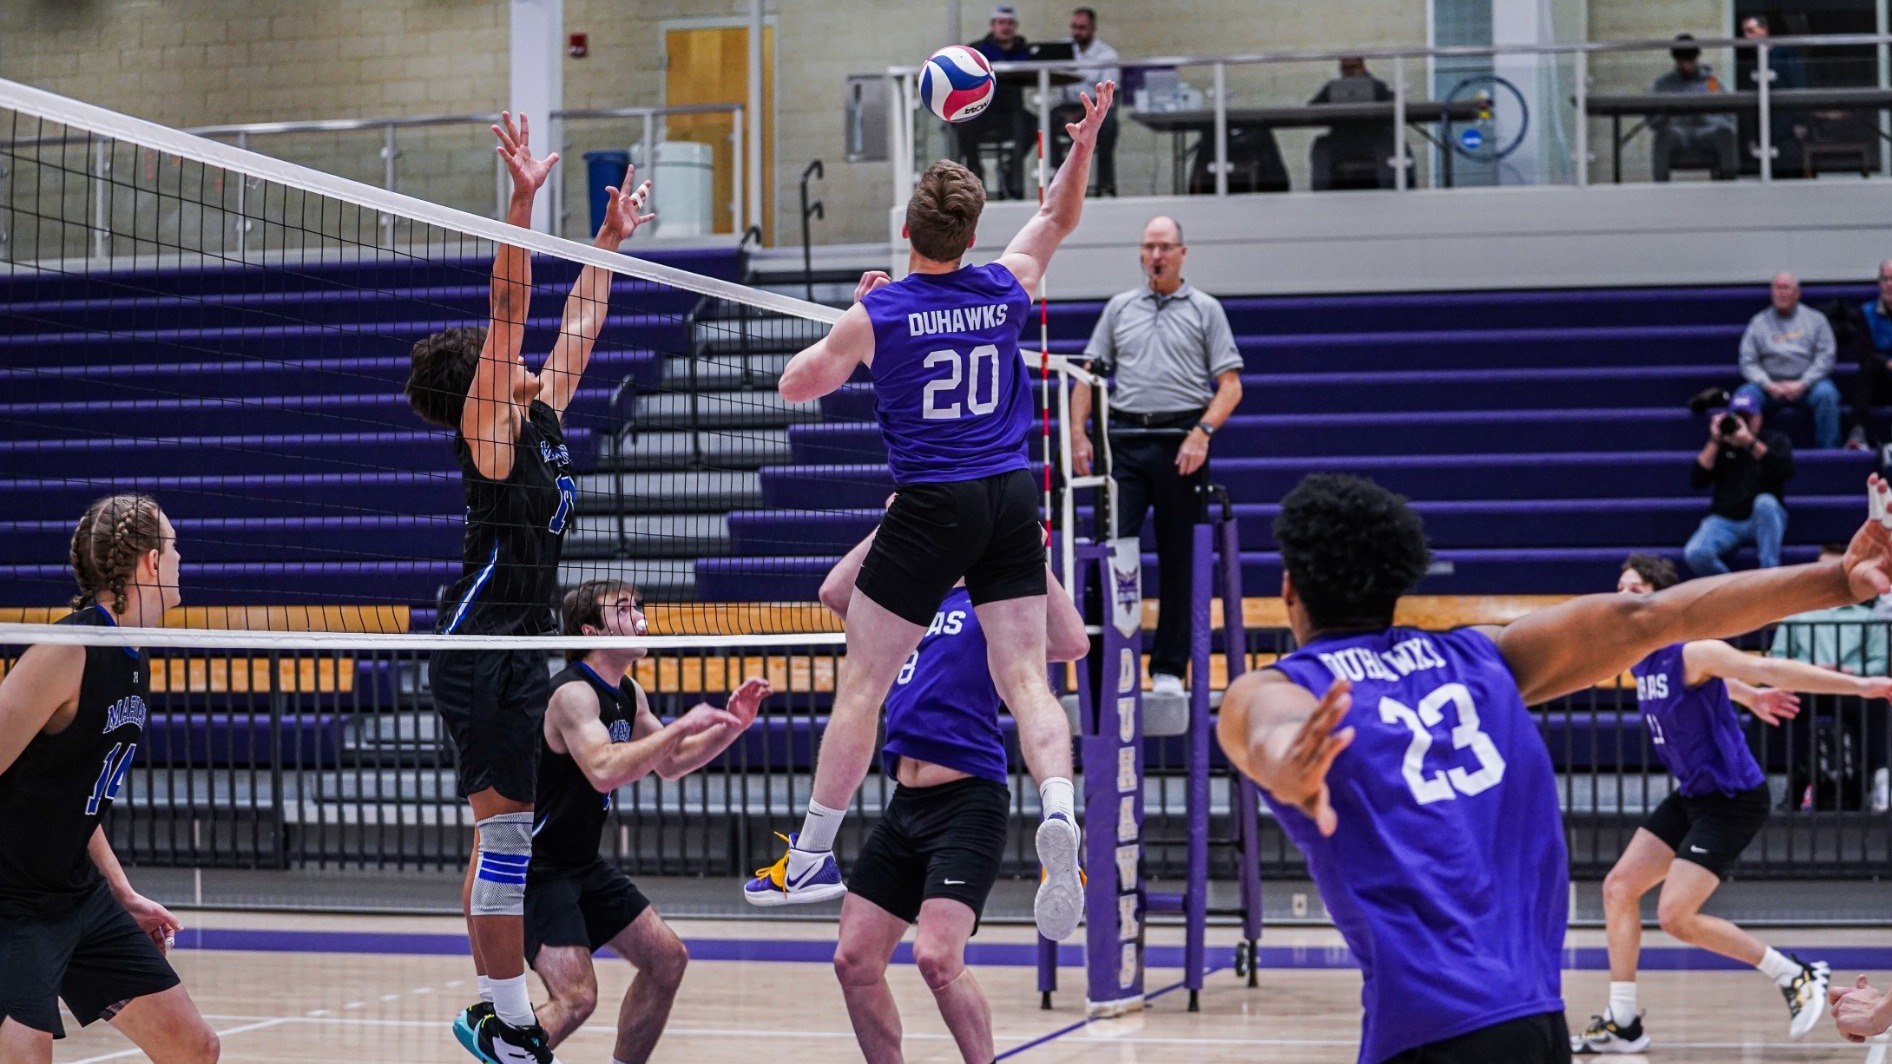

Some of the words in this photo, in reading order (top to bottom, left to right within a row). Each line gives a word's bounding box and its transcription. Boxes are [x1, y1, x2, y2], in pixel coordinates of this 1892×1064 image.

[907, 303, 1009, 337] DUHAWKS
[922, 343, 1000, 420] 20
[1378, 682, 1507, 806] 23
[1115, 647, 1140, 990] DUHAWKS
